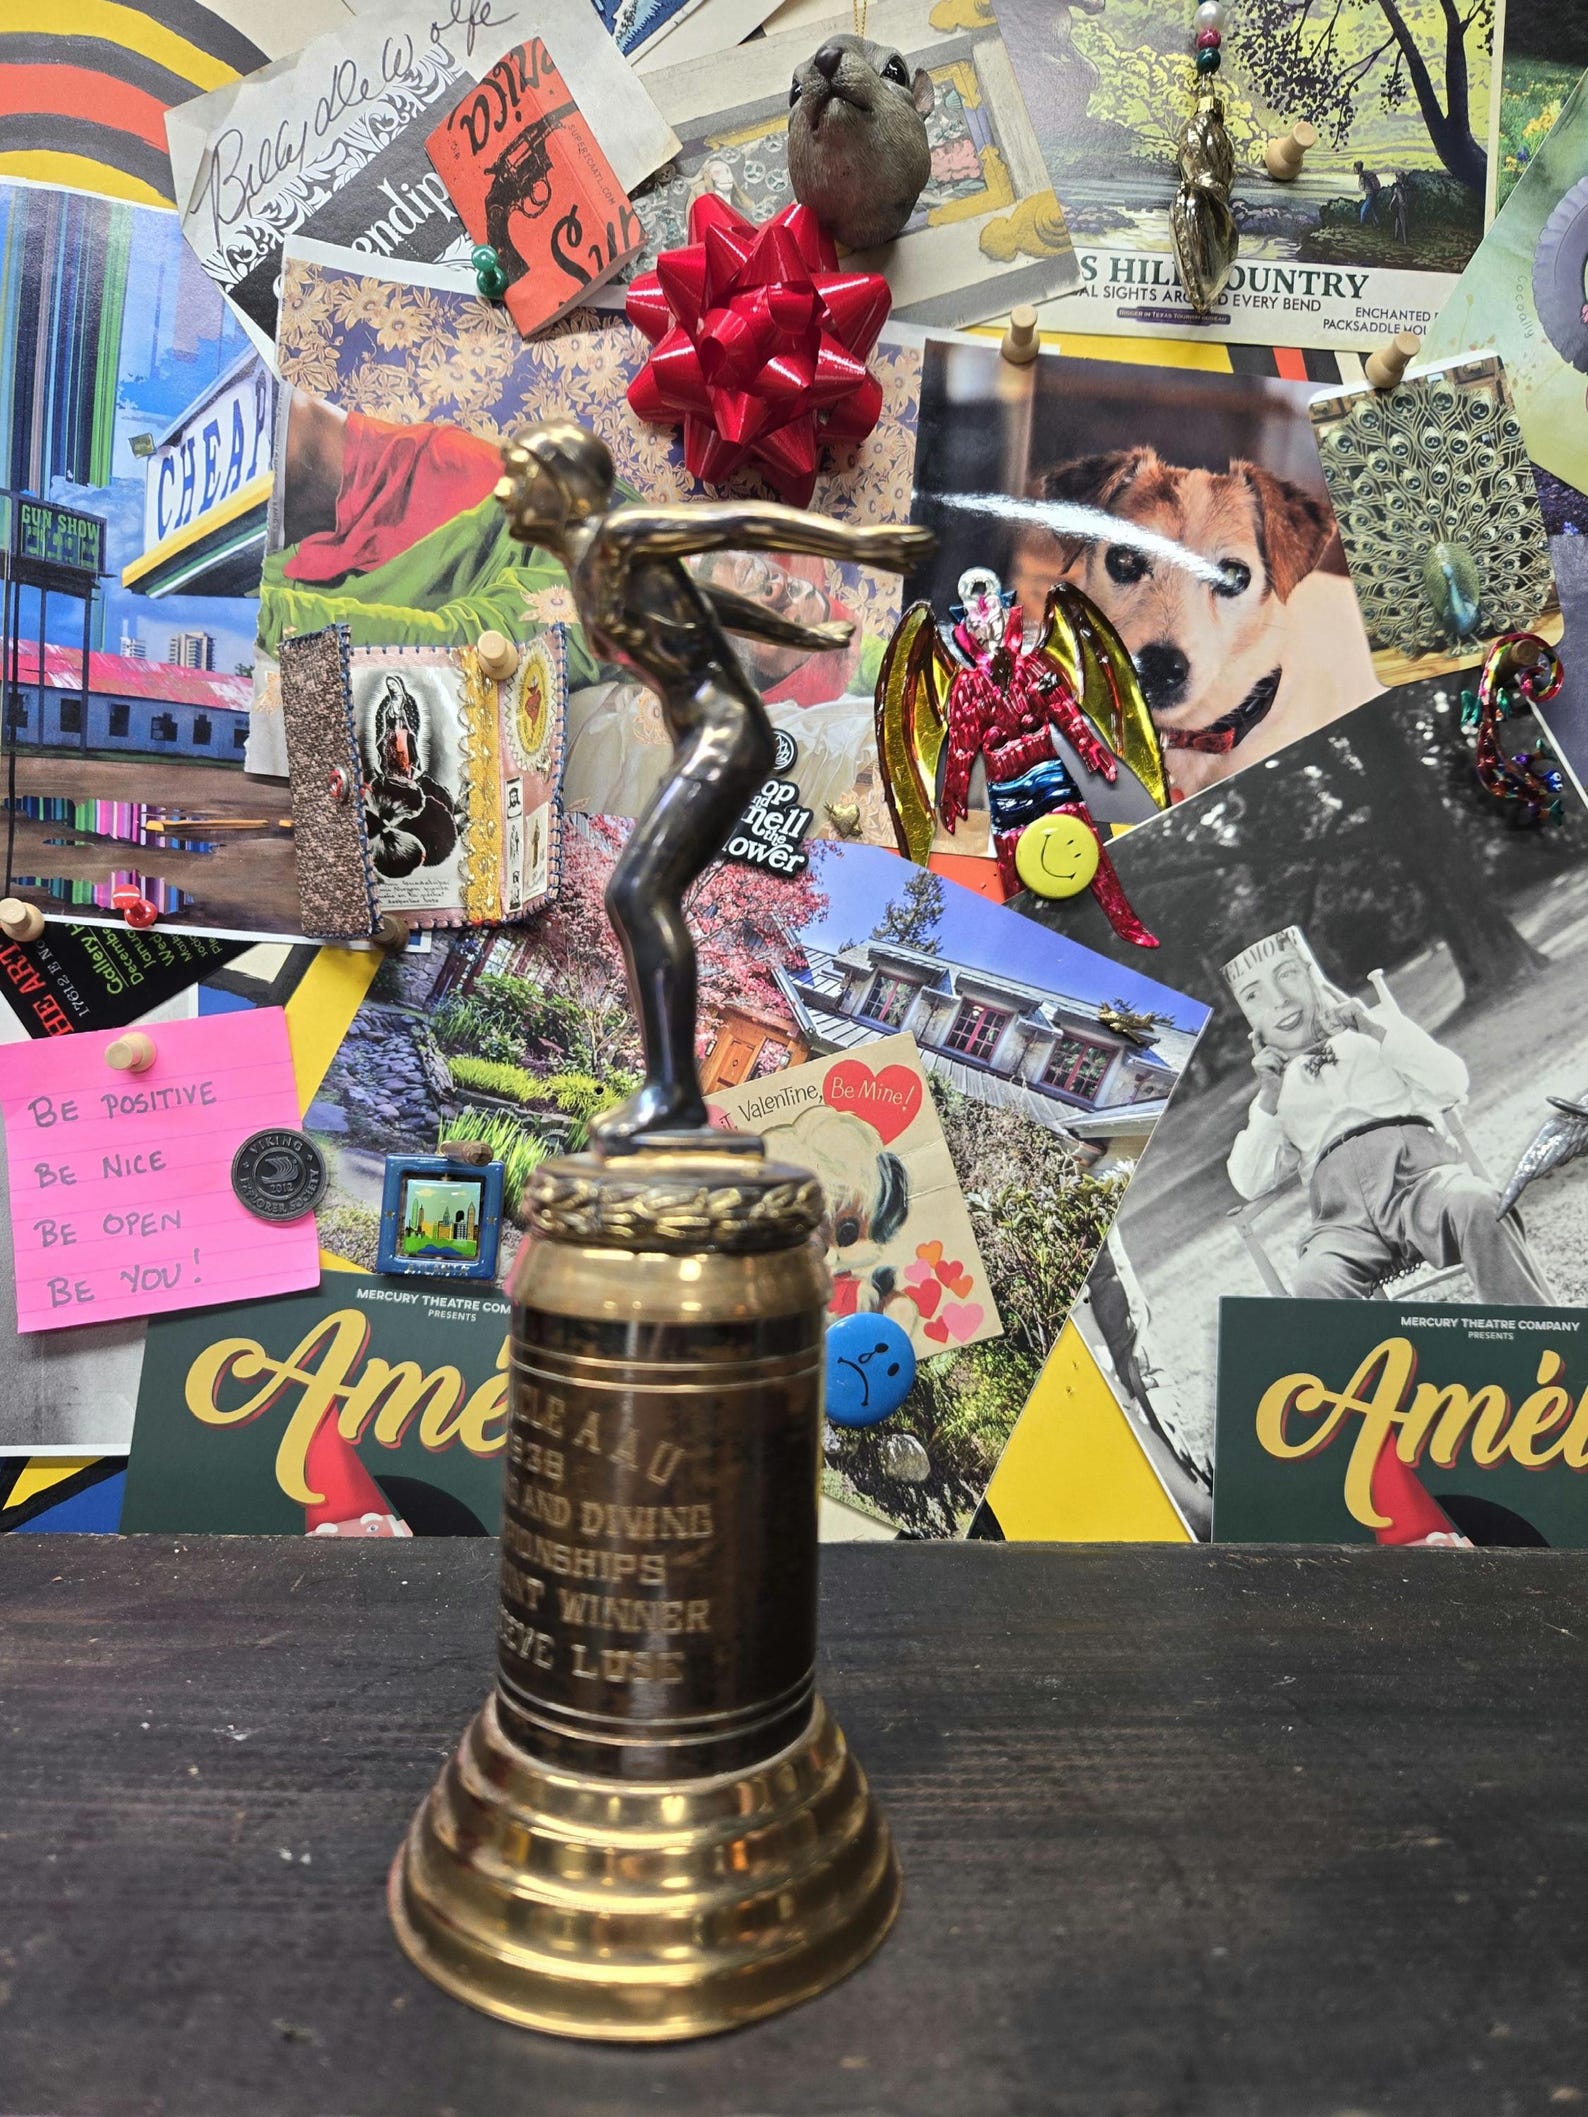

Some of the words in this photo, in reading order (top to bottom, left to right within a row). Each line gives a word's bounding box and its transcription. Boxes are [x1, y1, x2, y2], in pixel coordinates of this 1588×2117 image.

[352, 172, 458, 257] endip
[1103, 286, 1157, 302] SIGHTS
[1233, 294, 1279, 310] EVERY
[1283, 298, 1321, 312] BEND
[1228, 262, 1369, 300] OUNTRY
[1323, 318, 1400, 335] PACKSADDLE
[1355, 307, 1431, 322] ENCHANTED
[22, 504, 53, 529] GUN
[57, 514, 101, 540] SHOW
[751, 794, 772, 808] nd
[761, 780, 796, 805] op
[727, 836, 805, 872] ower
[763, 829, 787, 846] the
[47, 959, 62, 975] E
[82, 936, 124, 995] Gallery
[102, 927, 144, 986] Decembe
[57, 974, 91, 1018] 17612
[32, 993, 75, 1037] HE
[28, 1095, 79, 1128] BE
[100, 1081, 217, 1119] POSITIVE
[831, 1076, 855, 1099] Be
[858, 1080, 915, 1112] Mine!
[249, 1135, 303, 1154] VIKING
[34, 1162, 77, 1189] BE
[102, 1150, 167, 1180] NICE
[269, 1183, 295, 1194] 2012
[288, 1168, 320, 1211] SOCIETY
[33, 1219, 77, 1248] BE
[102, 1210, 182, 1237] OPEN
[47, 1276, 95, 1308] BE
[356, 1288, 419, 1305] MERCURY
[422, 1295, 480, 1311] THEATRE
[482, 1302, 512, 1315] COM
[427, 1309, 477, 1322] PRESENTS
[1400, 1316, 1459, 1328] MERCURY
[1461, 1317, 1516, 1330] THEATRE
[1518, 1319, 1580, 1332] COMPANY
[1468, 1331, 1514, 1341] PRESENTS
[184, 1308, 511, 1506] Amé
[557, 1587, 712, 1635] WINNER
